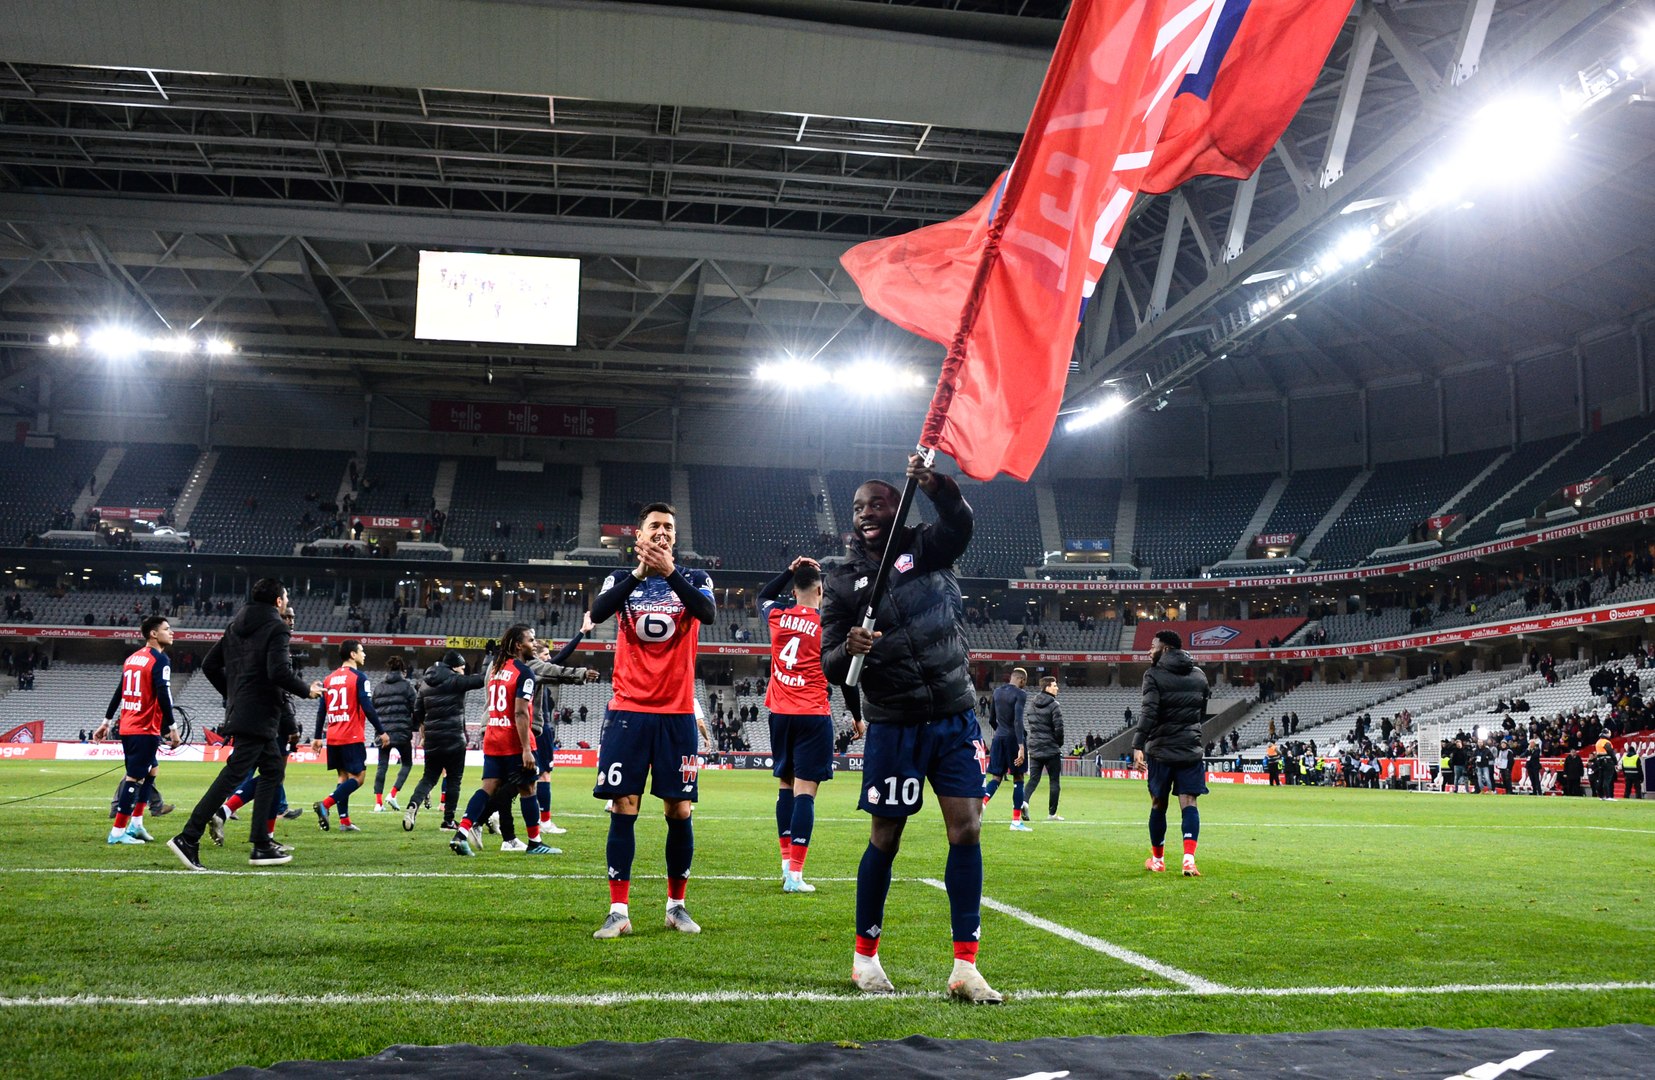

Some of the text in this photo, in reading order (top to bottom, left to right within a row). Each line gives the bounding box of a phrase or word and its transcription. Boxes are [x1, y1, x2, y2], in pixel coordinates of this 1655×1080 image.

[451, 404, 482, 420] hello
[508, 406, 538, 422] hello
[564, 408, 594, 425] hello
[372, 518, 400, 526] LOSC
[1639, 510, 1649, 518] DE
[1266, 535, 1290, 544] LOSC
[1498, 541, 1514, 551] LILLE
[1241, 578, 1292, 586] MÉTROPOLE
[1297, 574, 1349, 583] EUROPÉENNE
[630, 604, 684, 614] boulanger
[1618, 609, 1645, 618] boulanger
[780, 614, 818, 636] GABRIEL
[779, 636, 800, 670] 4
[124, 669, 142, 697] 11
[328, 687, 349, 711] 21
[488, 684, 507, 712] 18
[607, 762, 623, 786] 6
[884, 776, 920, 806] 10
